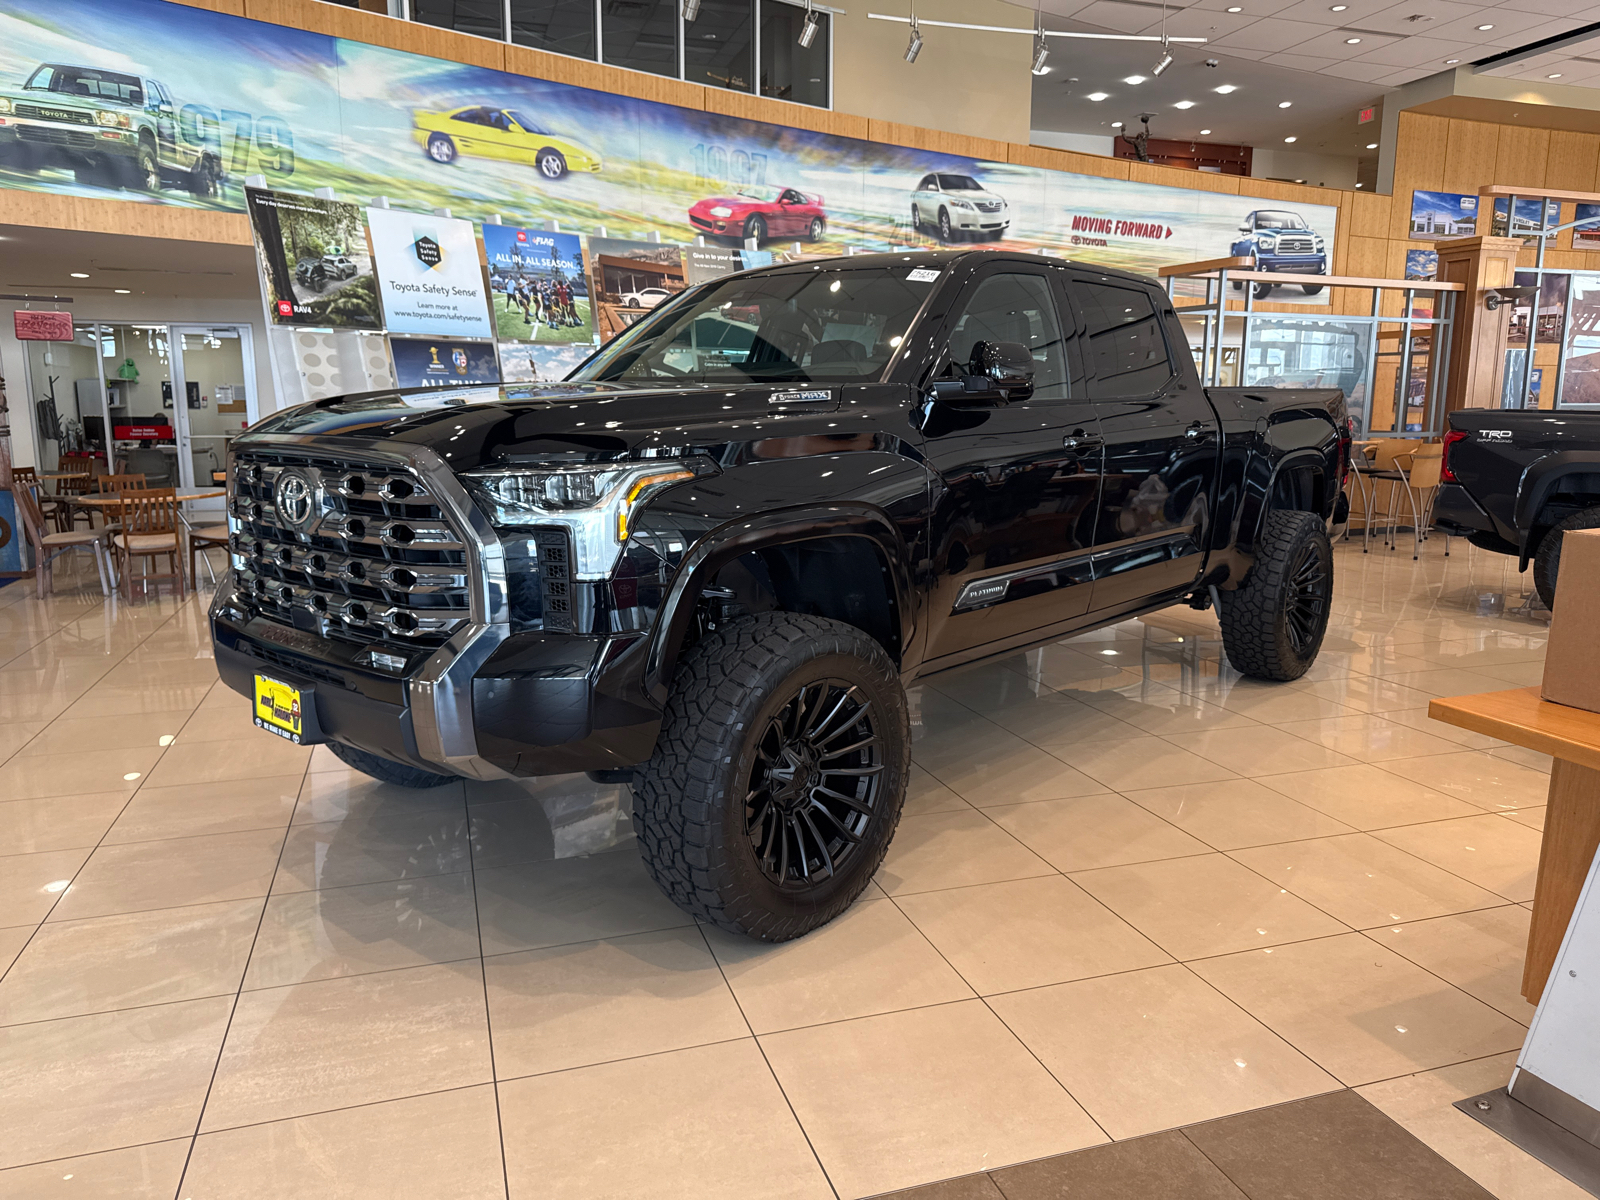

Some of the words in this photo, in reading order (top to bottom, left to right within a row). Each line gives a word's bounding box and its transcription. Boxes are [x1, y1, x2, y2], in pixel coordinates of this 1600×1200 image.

[40, 109, 68, 119] TOYOTA
[1360, 108, 1373, 122] EXIT
[255, 198, 269, 208] Every
[269, 200, 277, 208] day
[277, 202, 296, 210] deserves
[1071, 215, 1113, 235] MOVING
[1113, 220, 1163, 240] FORWARD
[418, 241, 437, 249] Toyota
[1081, 236, 1108, 247] TOYOTA
[420, 248, 438, 256] Safety
[692, 252, 704, 260] Give
[705, 252, 710, 260] in
[495, 253, 511, 262] ALL
[512, 254, 524, 264] IN.
[526, 256, 540, 266] ALL
[541, 258, 577, 270] SEASON.
[389, 280, 421, 293] Toyota
[422, 283, 450, 297] Safety
[293, 305, 312, 314] RAV4
[417, 301, 434, 309] Learn
[394, 310, 482, 323] www.toyota.com/safetysense
[800, 392, 828, 400] MAX
[1479, 429, 1512, 439] TRD
[970, 585, 1003, 598] PLATINUM
